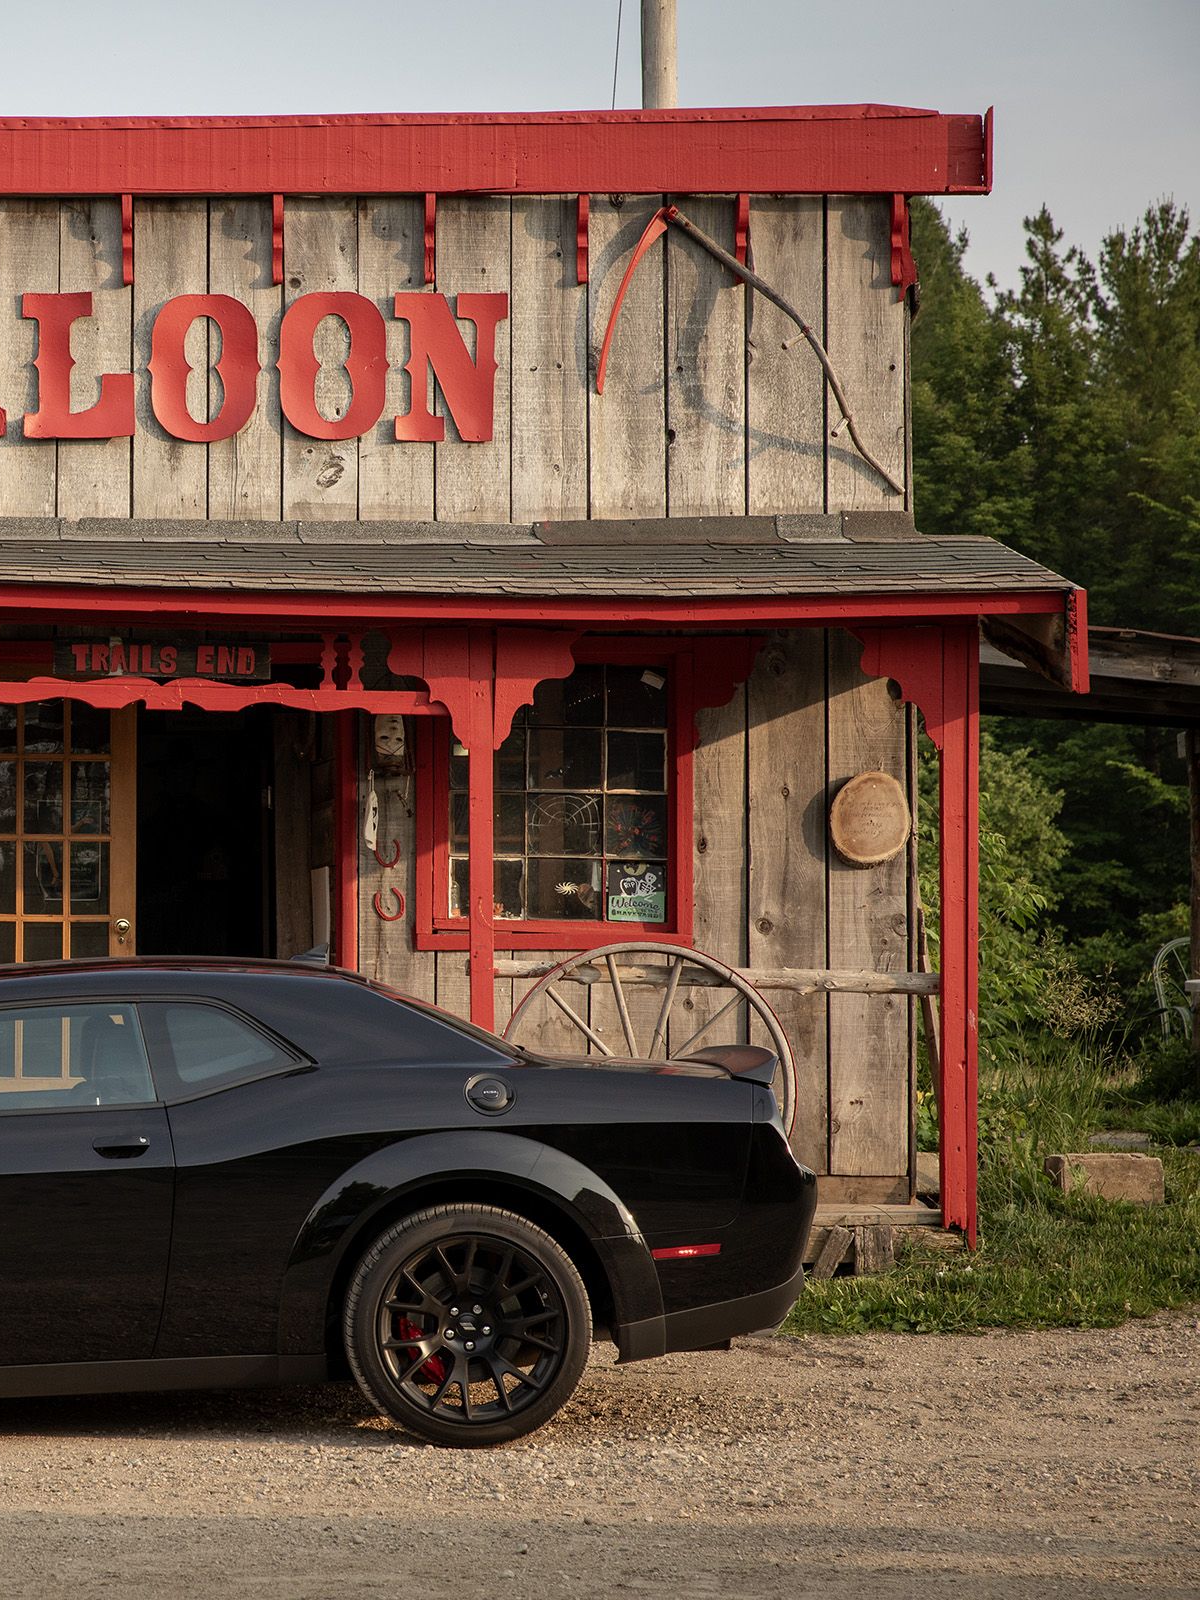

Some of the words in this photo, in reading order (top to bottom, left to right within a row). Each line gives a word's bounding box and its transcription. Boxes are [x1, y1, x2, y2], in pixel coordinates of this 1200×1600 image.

[71, 643, 177, 674] TRAILS
[196, 645, 256, 675] END
[611, 897, 661, 911] Welcome
